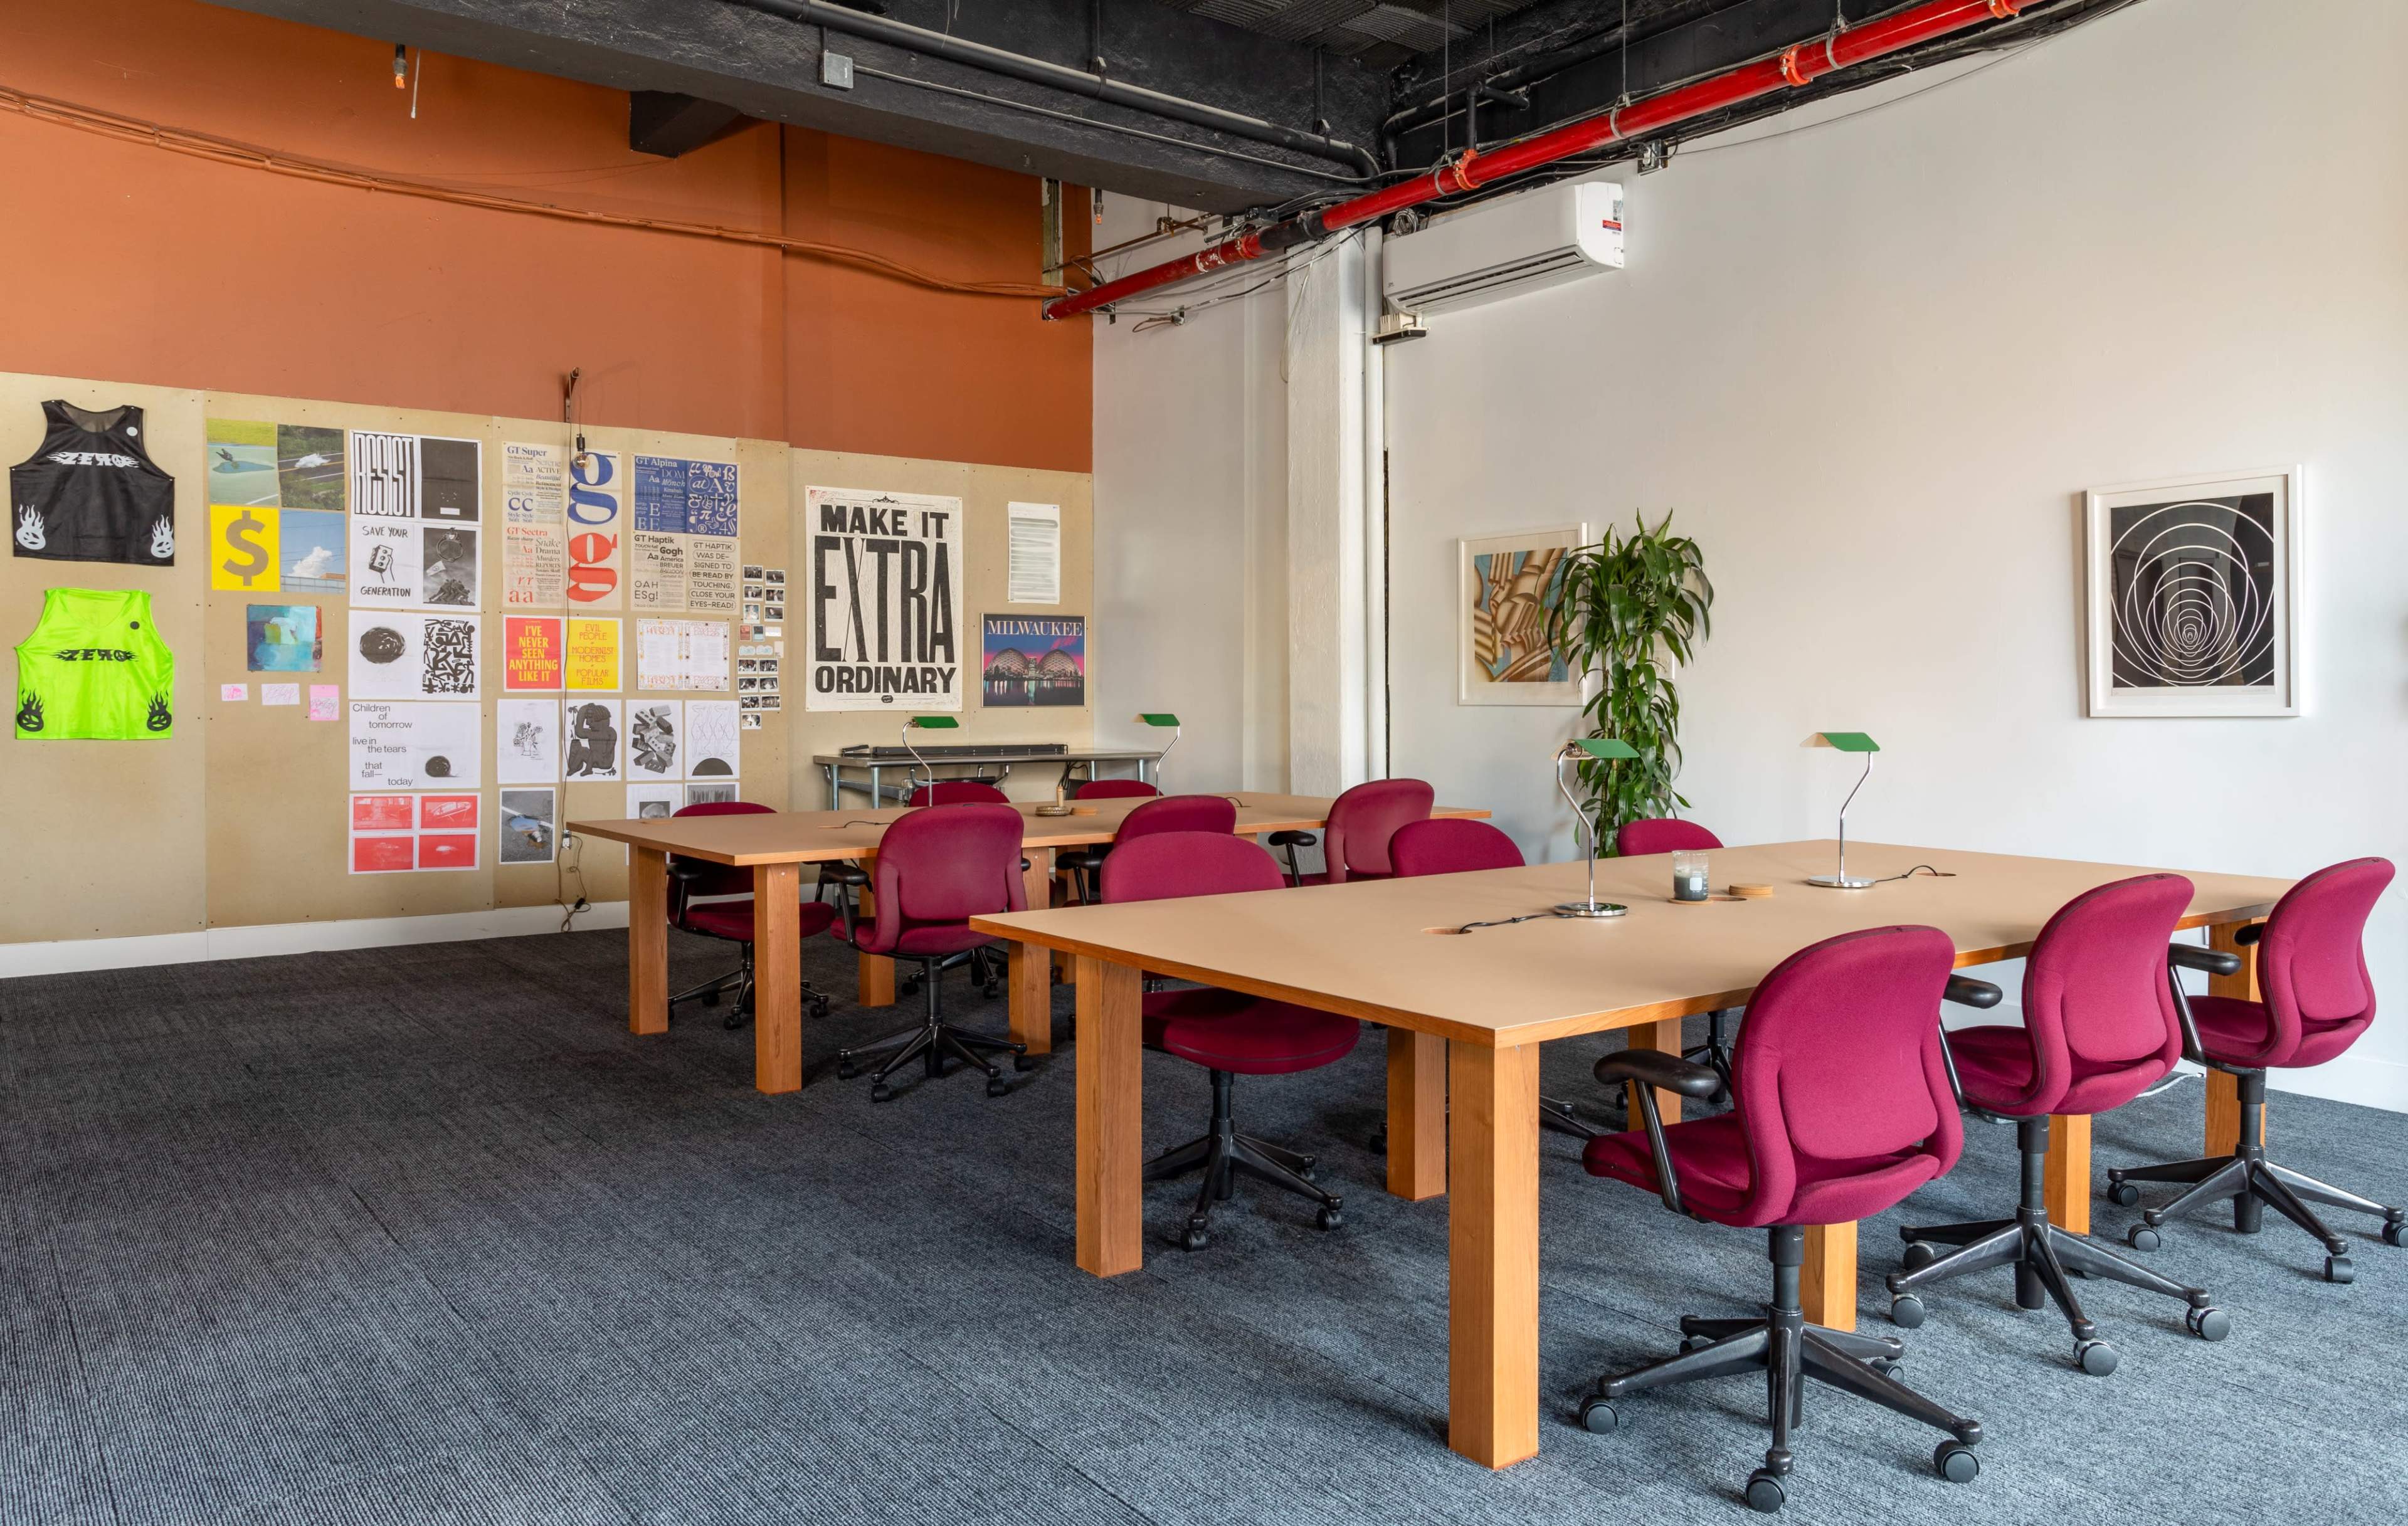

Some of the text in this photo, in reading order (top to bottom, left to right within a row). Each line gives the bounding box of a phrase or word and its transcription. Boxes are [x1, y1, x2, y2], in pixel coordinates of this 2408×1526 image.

[522, 447, 547, 458] Super
[636, 456, 677, 468] GT Alpina
[662, 469, 685, 479] DOM
[821, 504, 949, 539] MAKE IT
[362, 525, 408, 538] SAVE YOUR
[522, 527, 548, 537] Sectra
[536, 538, 561, 548] Snake
[648, 535, 675, 545] Haptik
[222, 510, 270, 586] $
[536, 547, 561, 555] Drama
[660, 546, 684, 557] Gogh
[694, 581, 732, 589] TOUCHING.
[361, 586, 411, 597] GENERATION
[635, 591, 658, 602] ESg!
[815, 535, 955, 663] EXTRA
[585, 624, 601, 632] EVIL
[986, 620, 1083, 636] MILWAUKEE
[579, 632, 607, 641] PEOPLE
[519, 636, 549, 648] NEVER
[522, 648, 545, 659] SEEN
[572, 647, 614, 655] MODERNIST
[509, 660, 558, 670] ANYTHING
[519, 671, 551, 682] LIKE IT
[576, 669, 609, 678] POPULAR
[582, 677, 603, 685] FILMS
[815, 666, 957, 693] ORDINARY
[352, 703, 391, 712] Children
[378, 712, 388, 720] of
[388, 778, 413, 787] today
